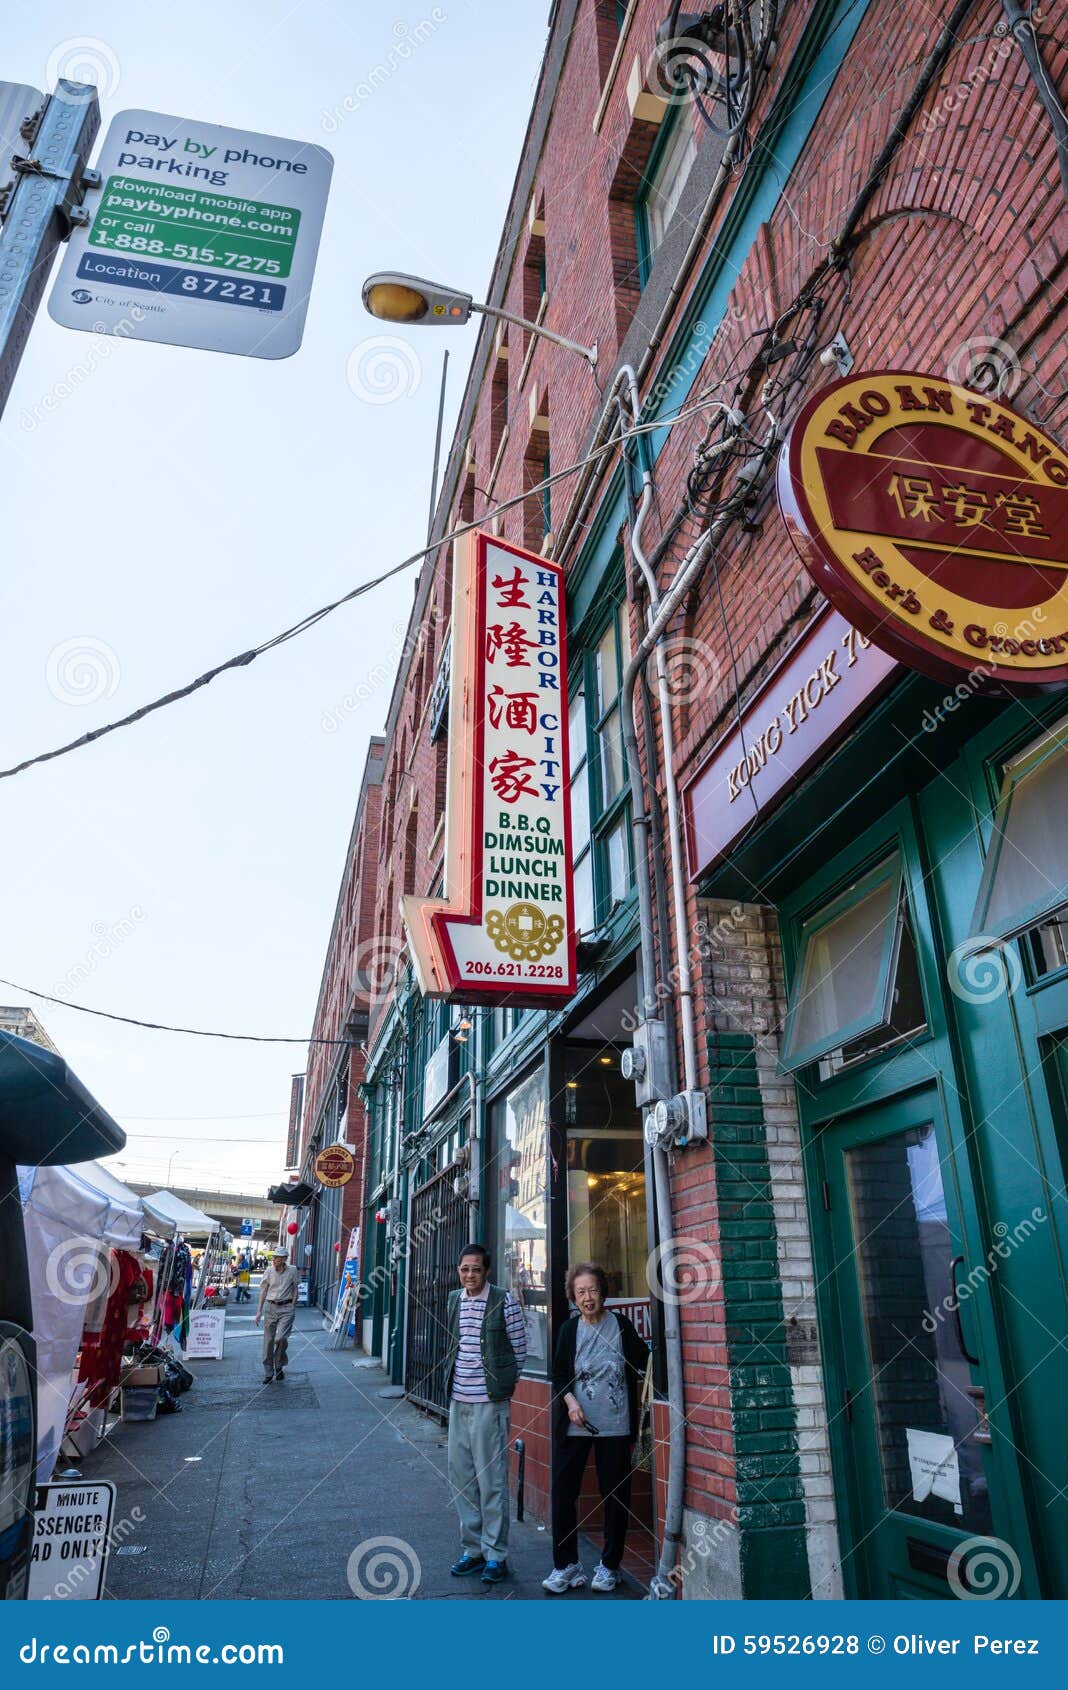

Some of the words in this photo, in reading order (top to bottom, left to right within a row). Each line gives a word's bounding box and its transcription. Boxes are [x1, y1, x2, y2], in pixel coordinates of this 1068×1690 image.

[117, 152, 230, 186] parking
[125, 129, 178, 151] pay
[184, 138, 218, 159] by
[223, 149, 308, 175] phone
[105, 194, 293, 236] paybyphone.com
[113, 179, 197, 203] download
[200, 196, 257, 214] mobile
[261, 208, 292, 221] app
[101, 217, 120, 227] or
[124, 221, 155, 234] call
[95, 230, 281, 274] 1-888-515-7275
[85, 260, 161, 282] Location
[182, 276, 271, 304] 87221
[95, 295, 116, 307] City
[132, 301, 167, 313] Seattle
[825, 390, 891, 449] BAO
[895, 385, 954, 415] AN
[966, 401, 1068, 486] TANG
[887, 471, 1052, 540] 保安堂
[851, 546, 922, 615] Herb
[929, 609, 954, 635] &
[536, 571, 559, 690] HARBOR
[486, 566, 543, 804] 生隆酒家
[726, 717, 783, 803] KONG
[782, 650, 841, 734] YICK
[539, 714, 561, 801] CITY
[484, 832, 565, 855] DIMSUM
[499, 812, 551, 835] B.B.Q
[490, 856, 557, 878] LUNCH
[486, 879, 562, 902] DINNER
[466, 961, 563, 979] 206.621.2228
[57, 1492, 99, 1507] MINUTE
[35, 1514, 103, 1536] SSENGER
[31, 1543, 52, 1562] AD
[60, 1539, 102, 1560] ONLY
